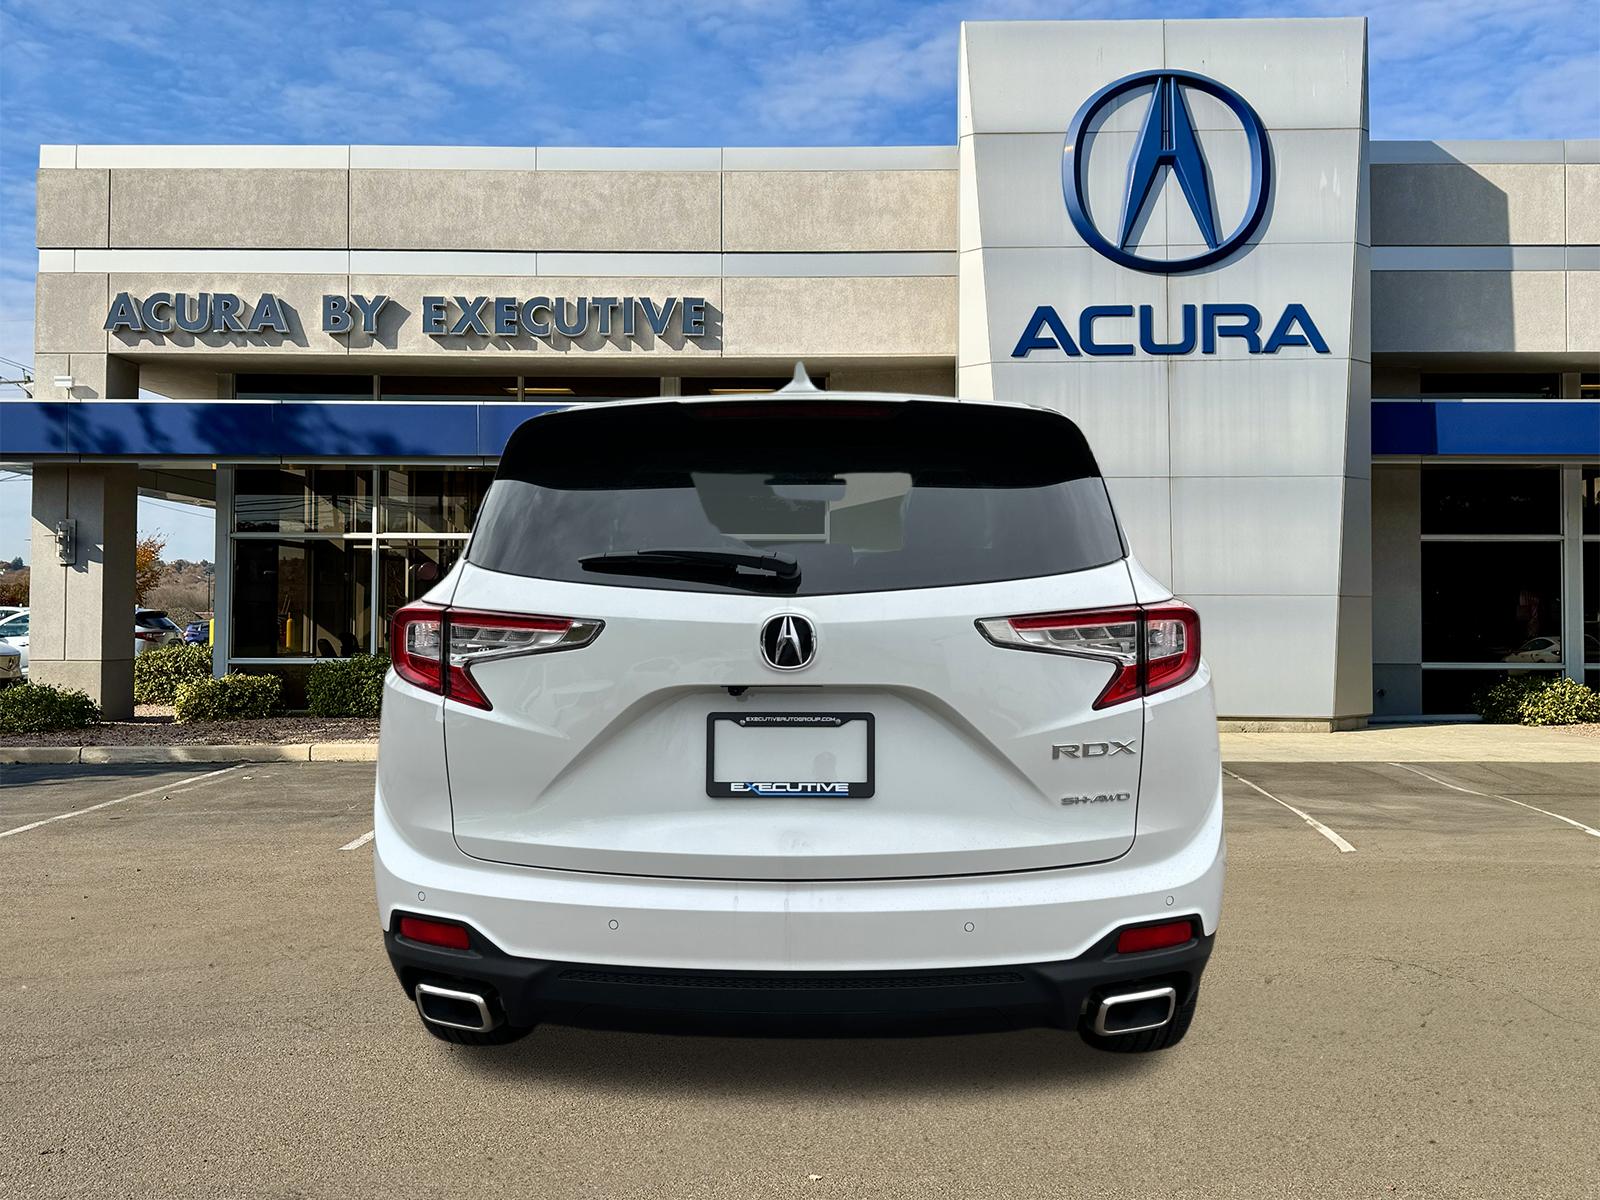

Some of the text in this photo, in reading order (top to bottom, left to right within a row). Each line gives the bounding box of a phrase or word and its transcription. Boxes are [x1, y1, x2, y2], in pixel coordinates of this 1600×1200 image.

[103, 292, 706, 337] ACURA BY EXECUTIVE
[1011, 303, 1332, 358] ACURA
[1052, 738, 1136, 760] RDX
[730, 782, 849, 792] EXECUTIVE
[1061, 793, 1130, 806] SH-AWD
